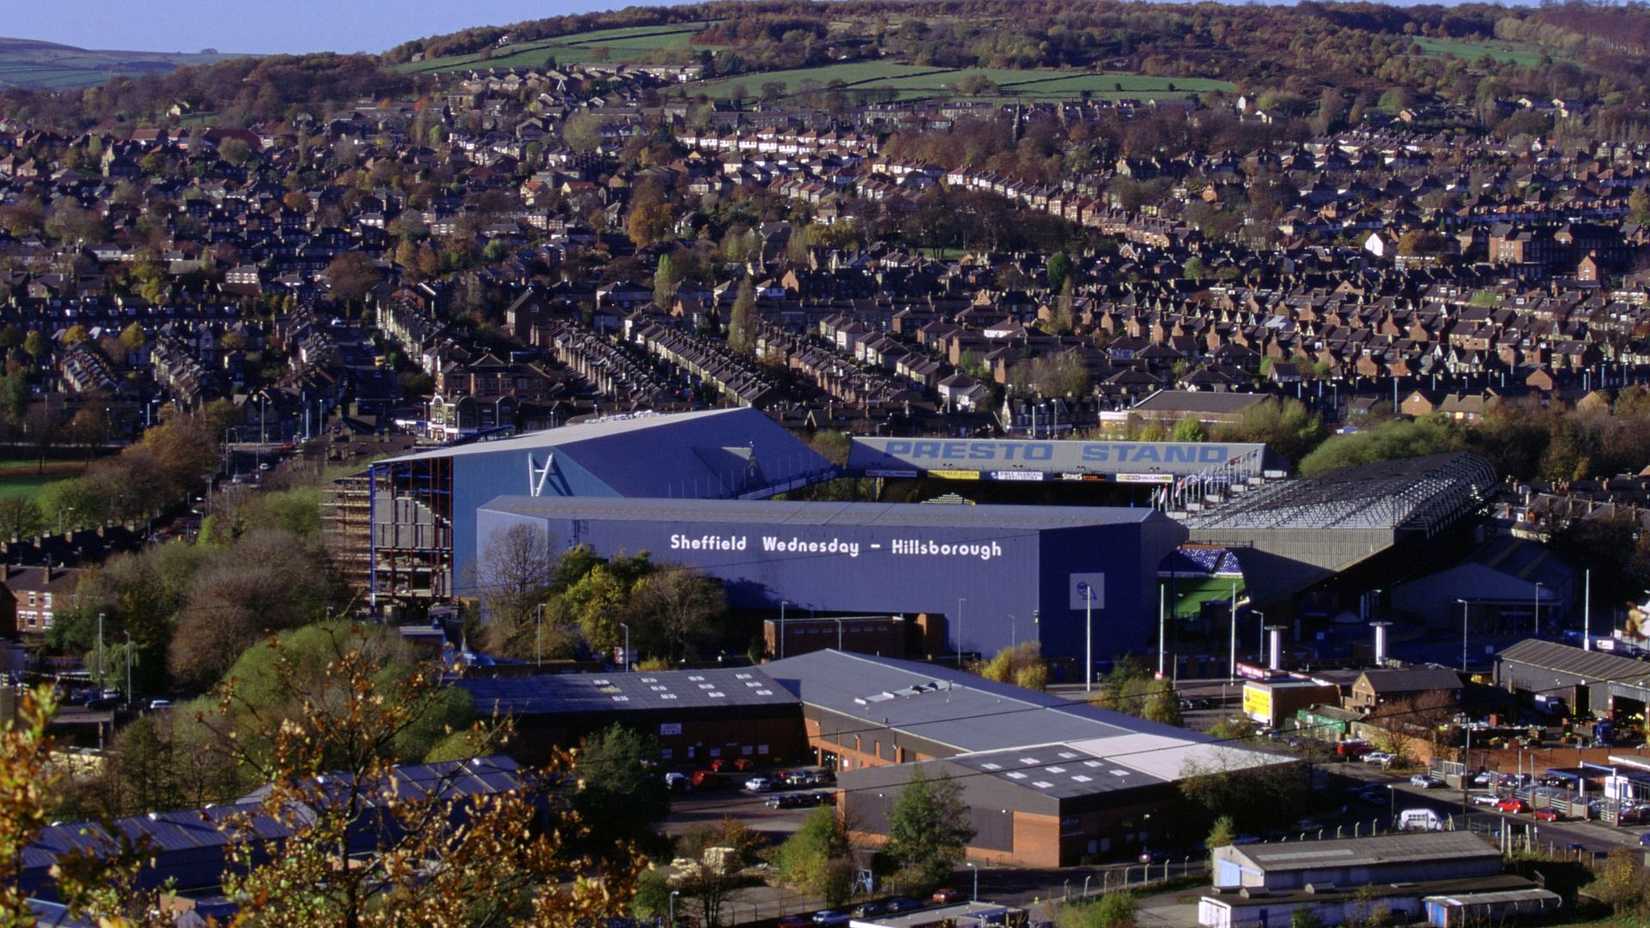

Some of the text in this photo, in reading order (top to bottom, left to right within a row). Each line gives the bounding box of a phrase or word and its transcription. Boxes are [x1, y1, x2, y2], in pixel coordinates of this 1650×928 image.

[885, 441, 1229, 463] PRESTO STAND
[670, 534, 747, 551] Sheffield
[762, 536, 859, 557] Wednesday
[892, 539, 1002, 560] Hillsborough
